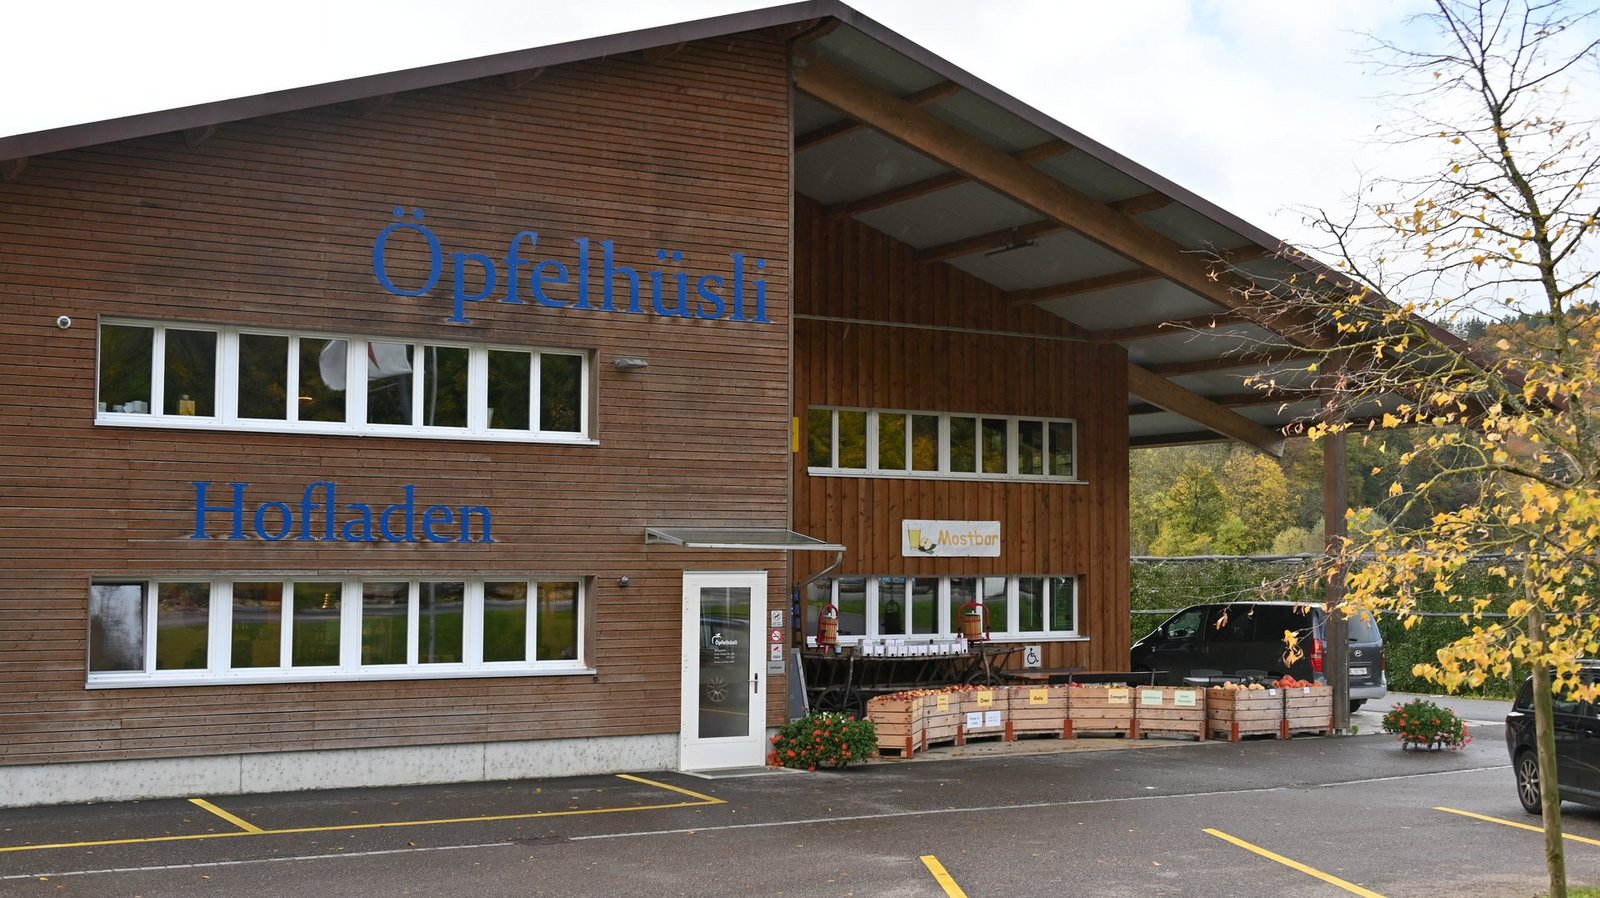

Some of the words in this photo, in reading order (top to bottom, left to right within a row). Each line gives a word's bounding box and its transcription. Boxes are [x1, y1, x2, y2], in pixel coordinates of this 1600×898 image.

[371, 206, 773, 325] Öpfelhüsli
[189, 480, 496, 543] Hofladen
[937, 529, 999, 547] Mostbar
